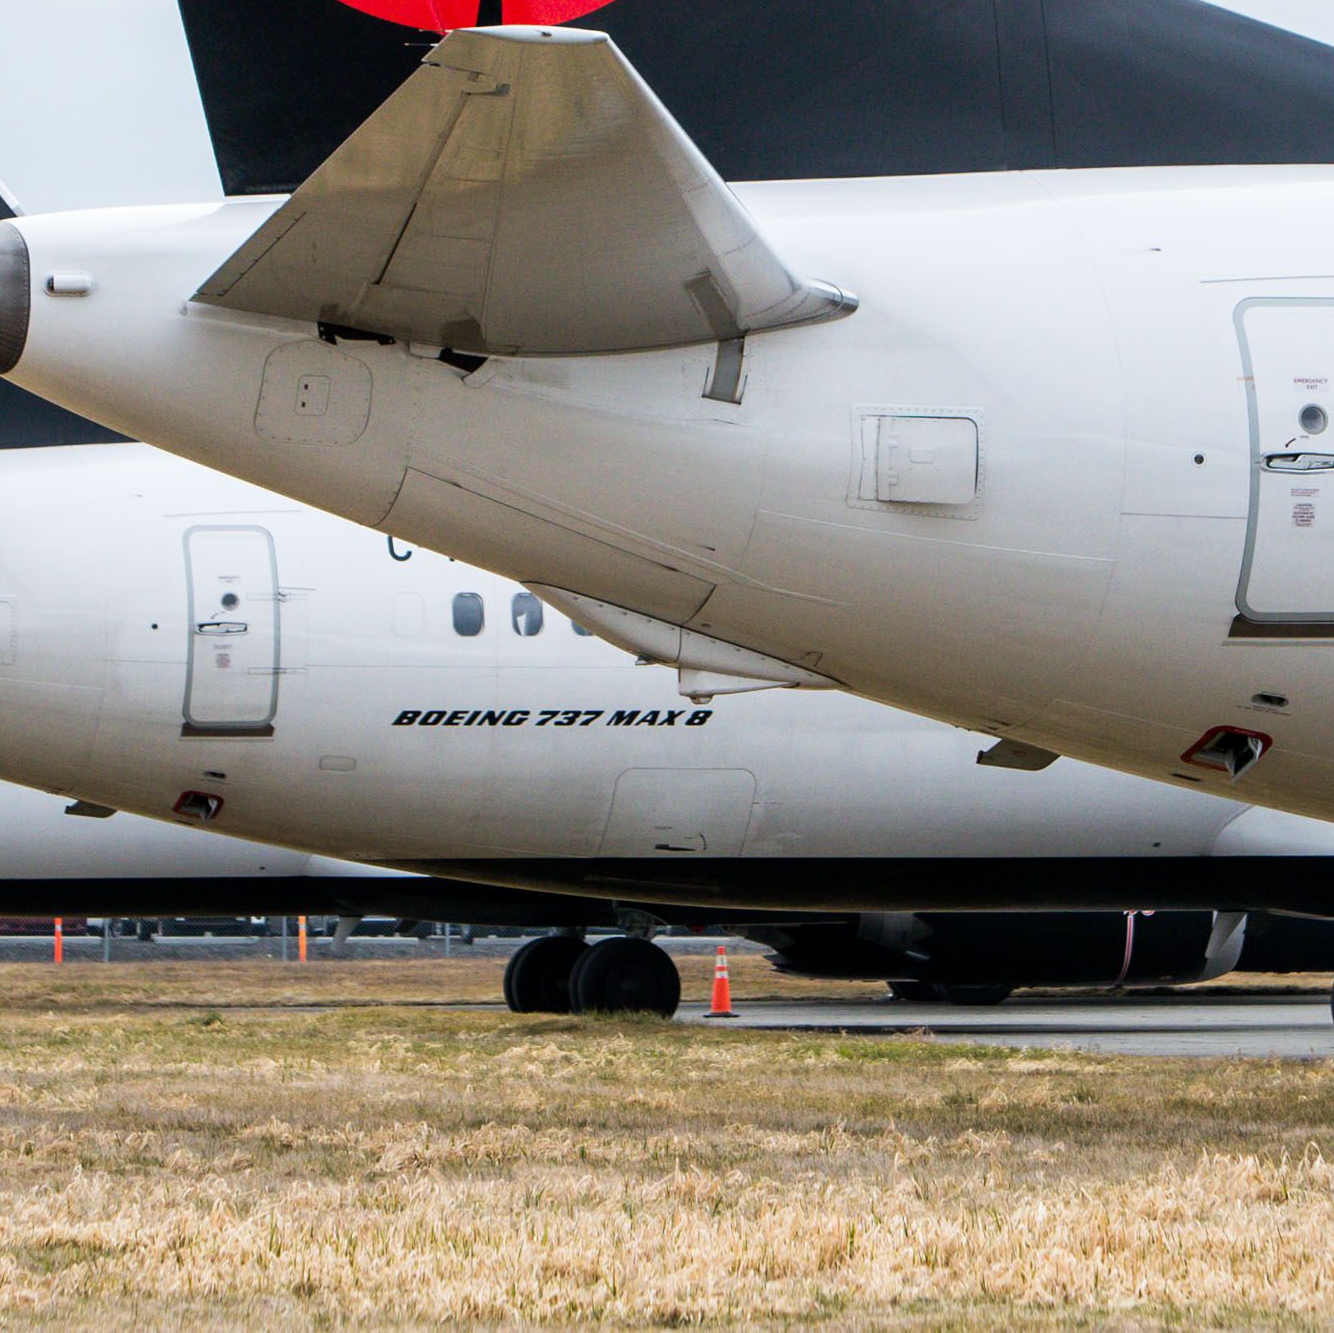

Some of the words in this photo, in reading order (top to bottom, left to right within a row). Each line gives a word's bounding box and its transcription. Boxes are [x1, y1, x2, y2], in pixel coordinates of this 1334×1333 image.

[391, 710, 530, 726] BOEING
[534, 710, 605, 726] 737
[605, 710, 686, 726] MAX
[684, 710, 713, 726] 8
